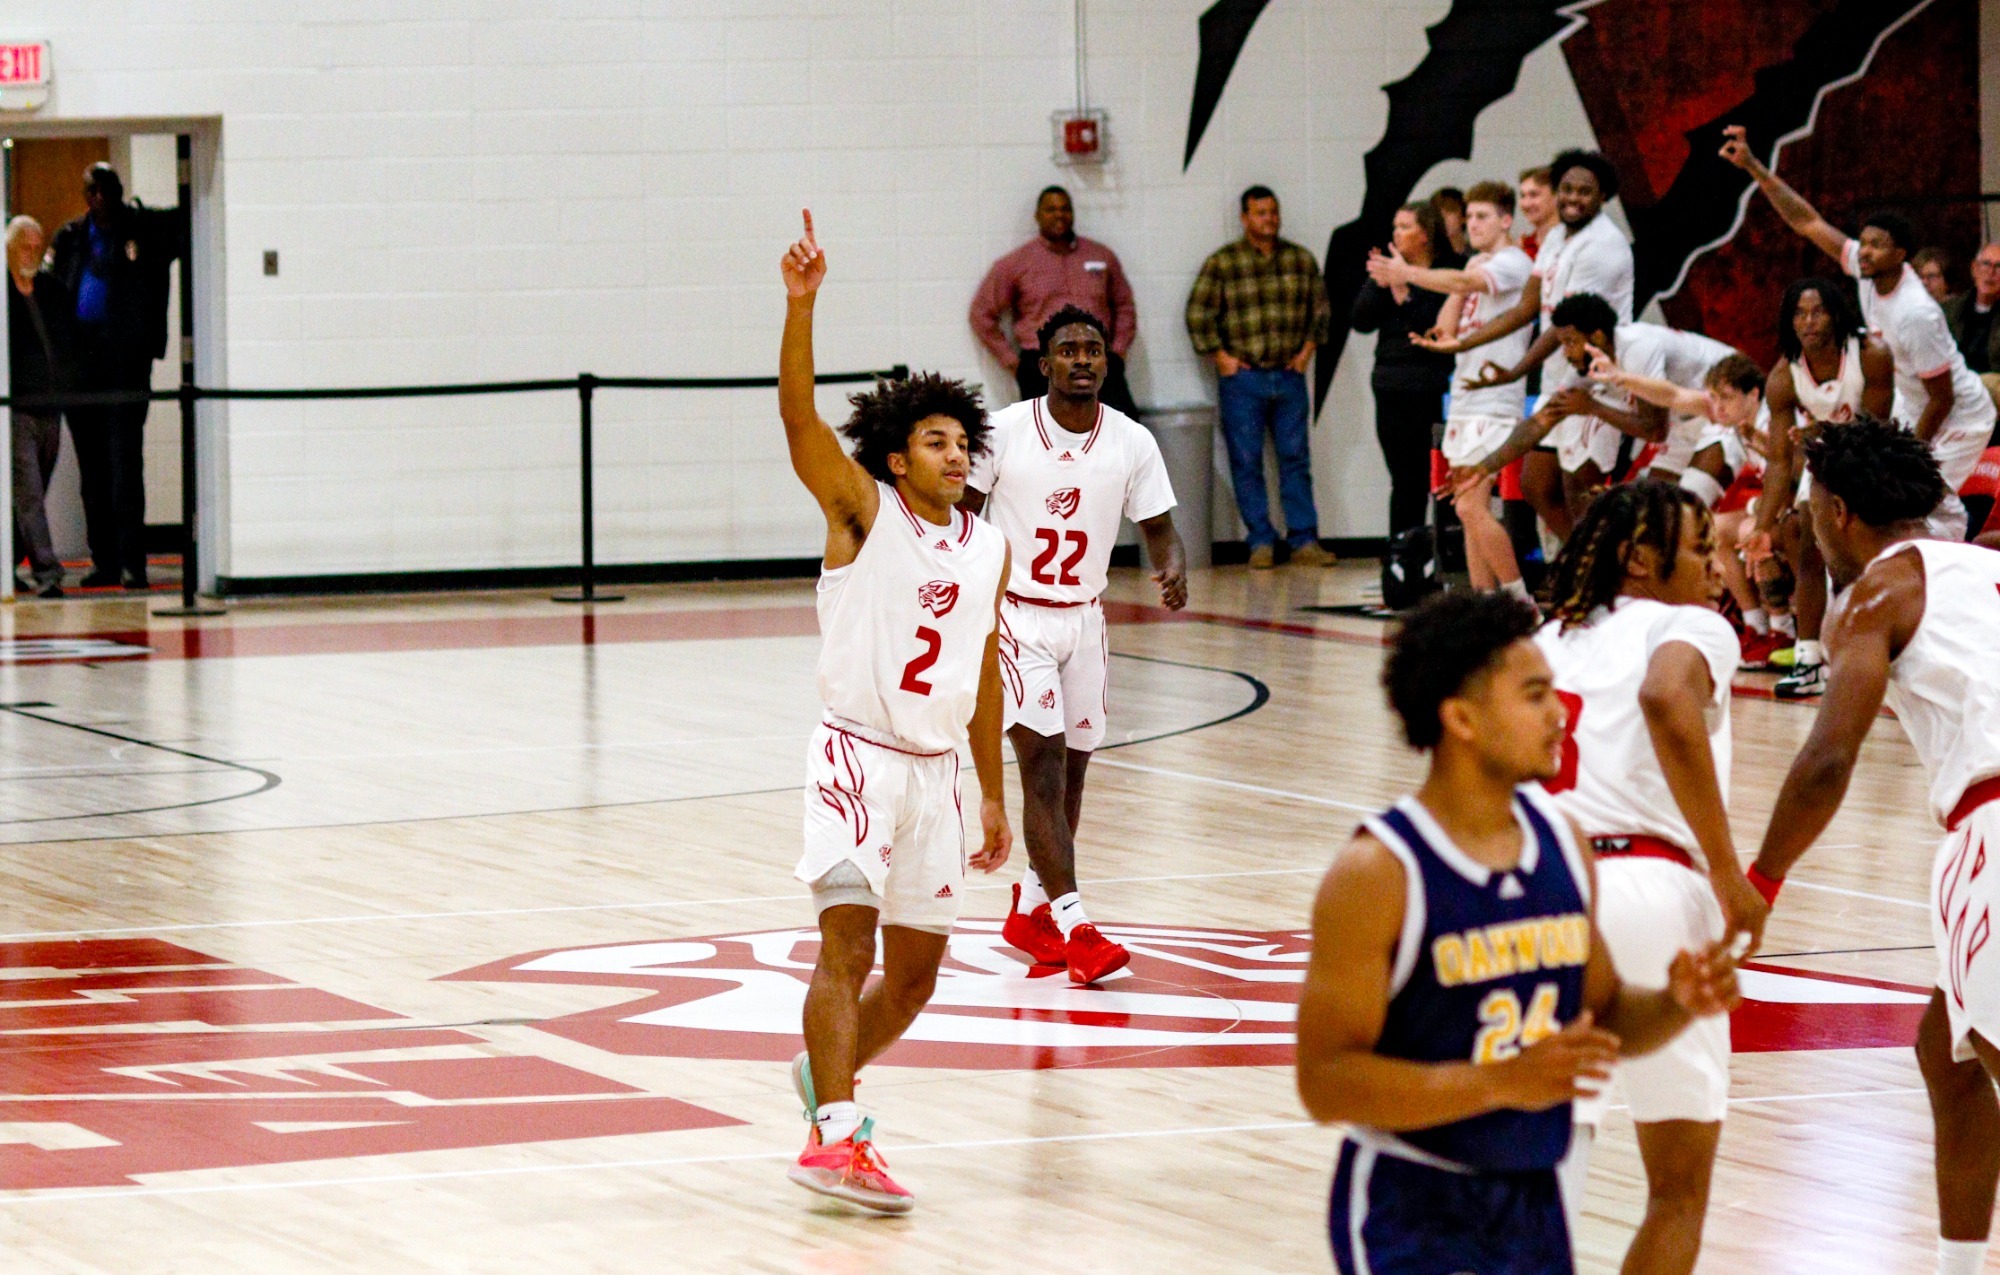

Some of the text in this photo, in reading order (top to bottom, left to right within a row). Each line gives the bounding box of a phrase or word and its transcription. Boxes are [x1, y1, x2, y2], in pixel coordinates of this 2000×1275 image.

[0, 45, 42, 83] EXIT
[1031, 528, 1088, 585] 22
[899, 625, 942, 697] 2
[1471, 982, 1562, 1066] 24
